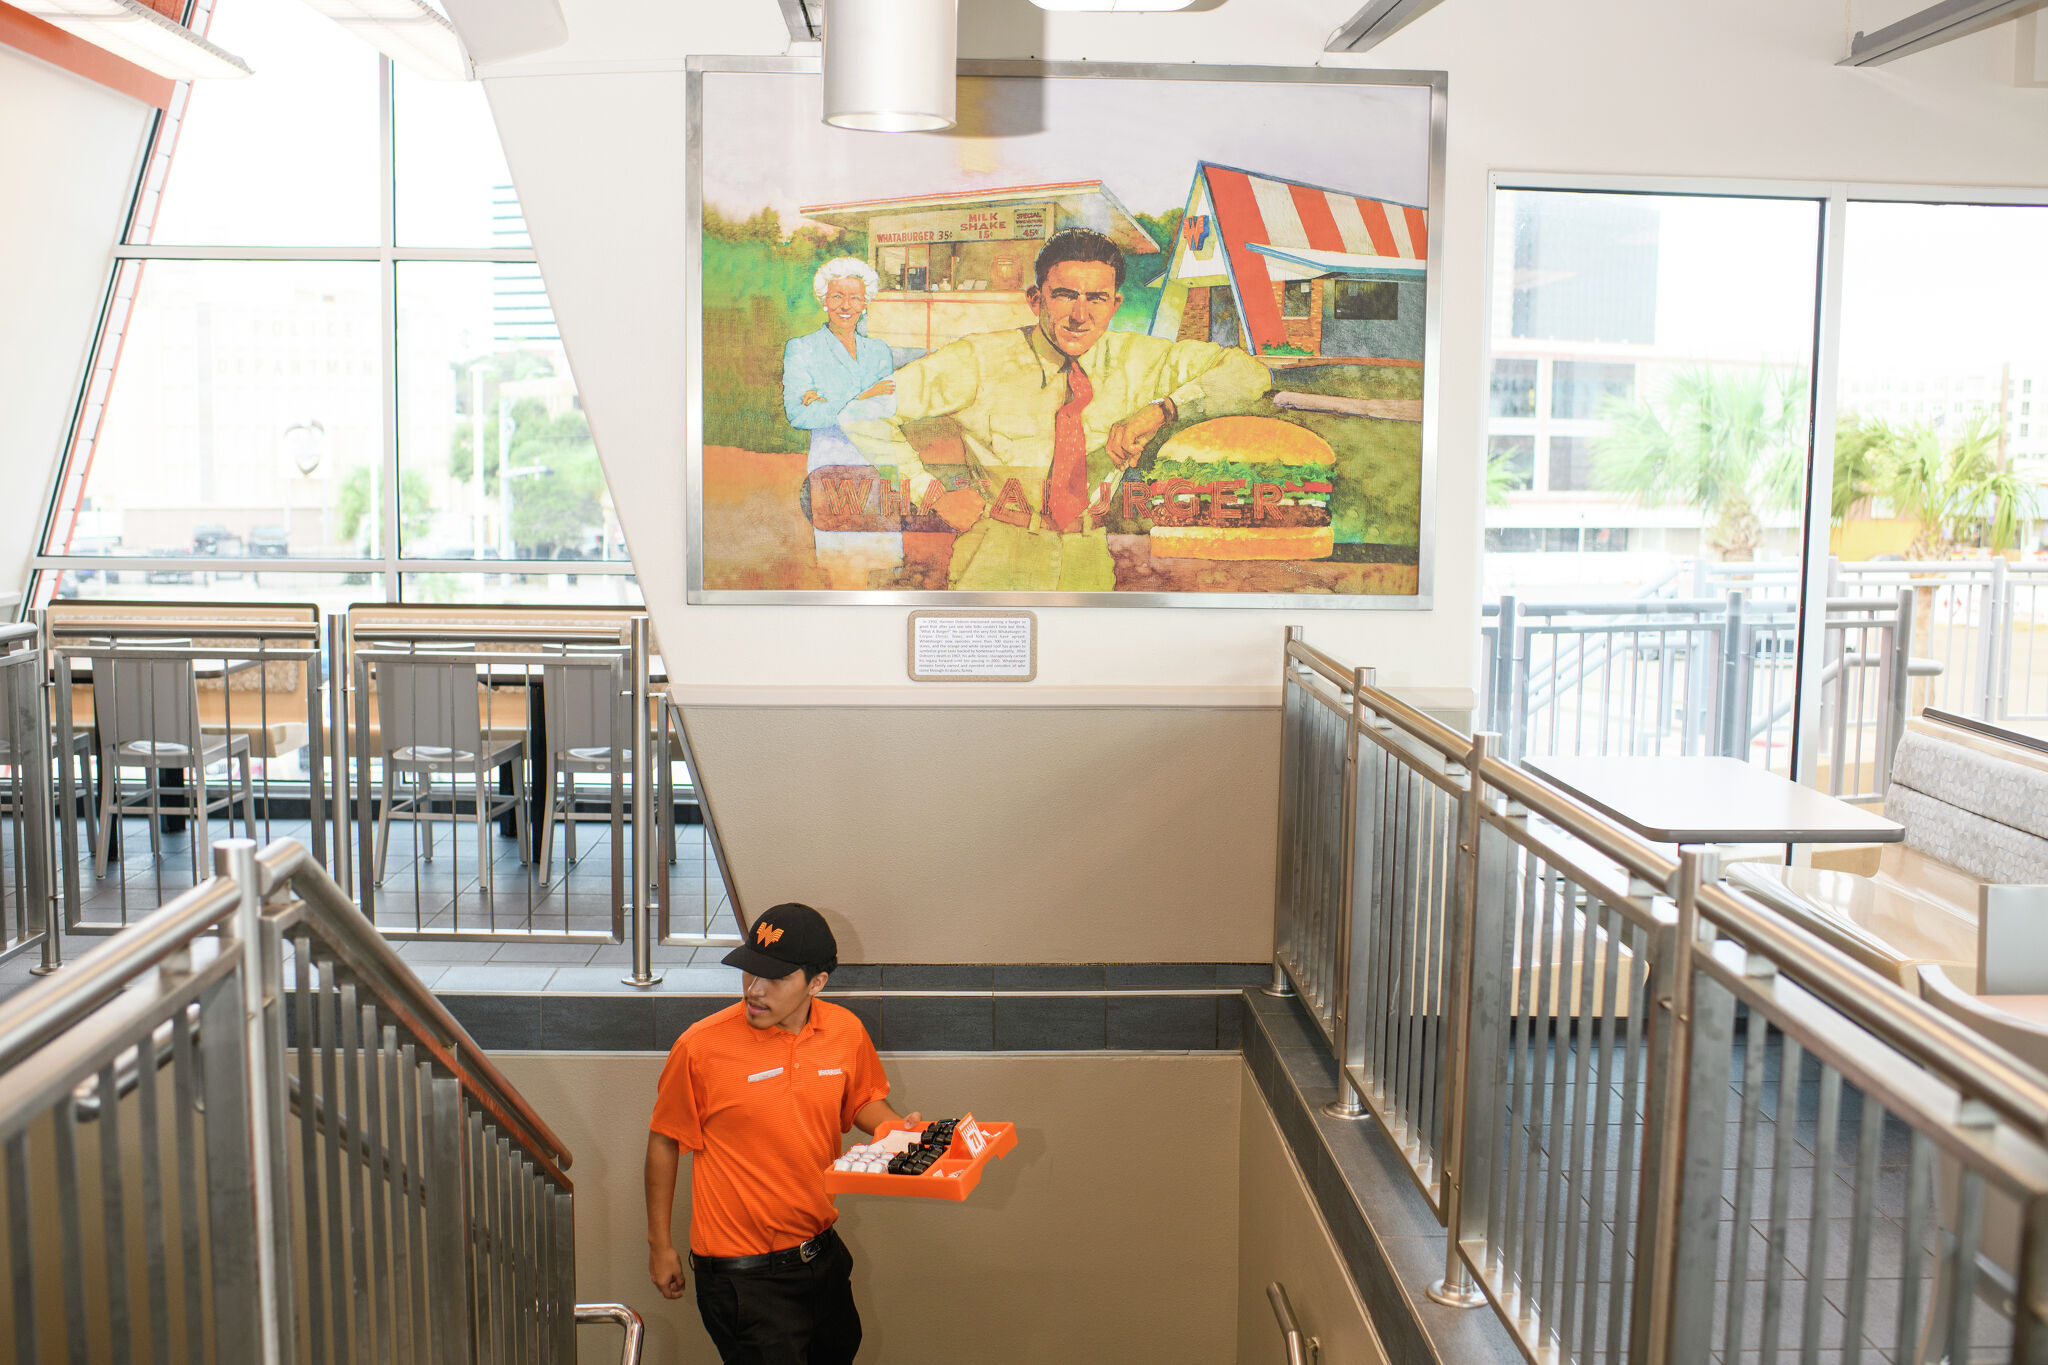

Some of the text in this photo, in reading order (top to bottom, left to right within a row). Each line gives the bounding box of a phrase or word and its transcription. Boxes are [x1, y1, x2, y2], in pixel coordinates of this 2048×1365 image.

[968, 212, 998, 222] MILK
[960, 221, 1006, 231] SHAKE
[877, 230, 935, 243] WHATABURGER
[254, 319, 353, 339] POLICE
[215, 357, 374, 377] DEPARTMEN
